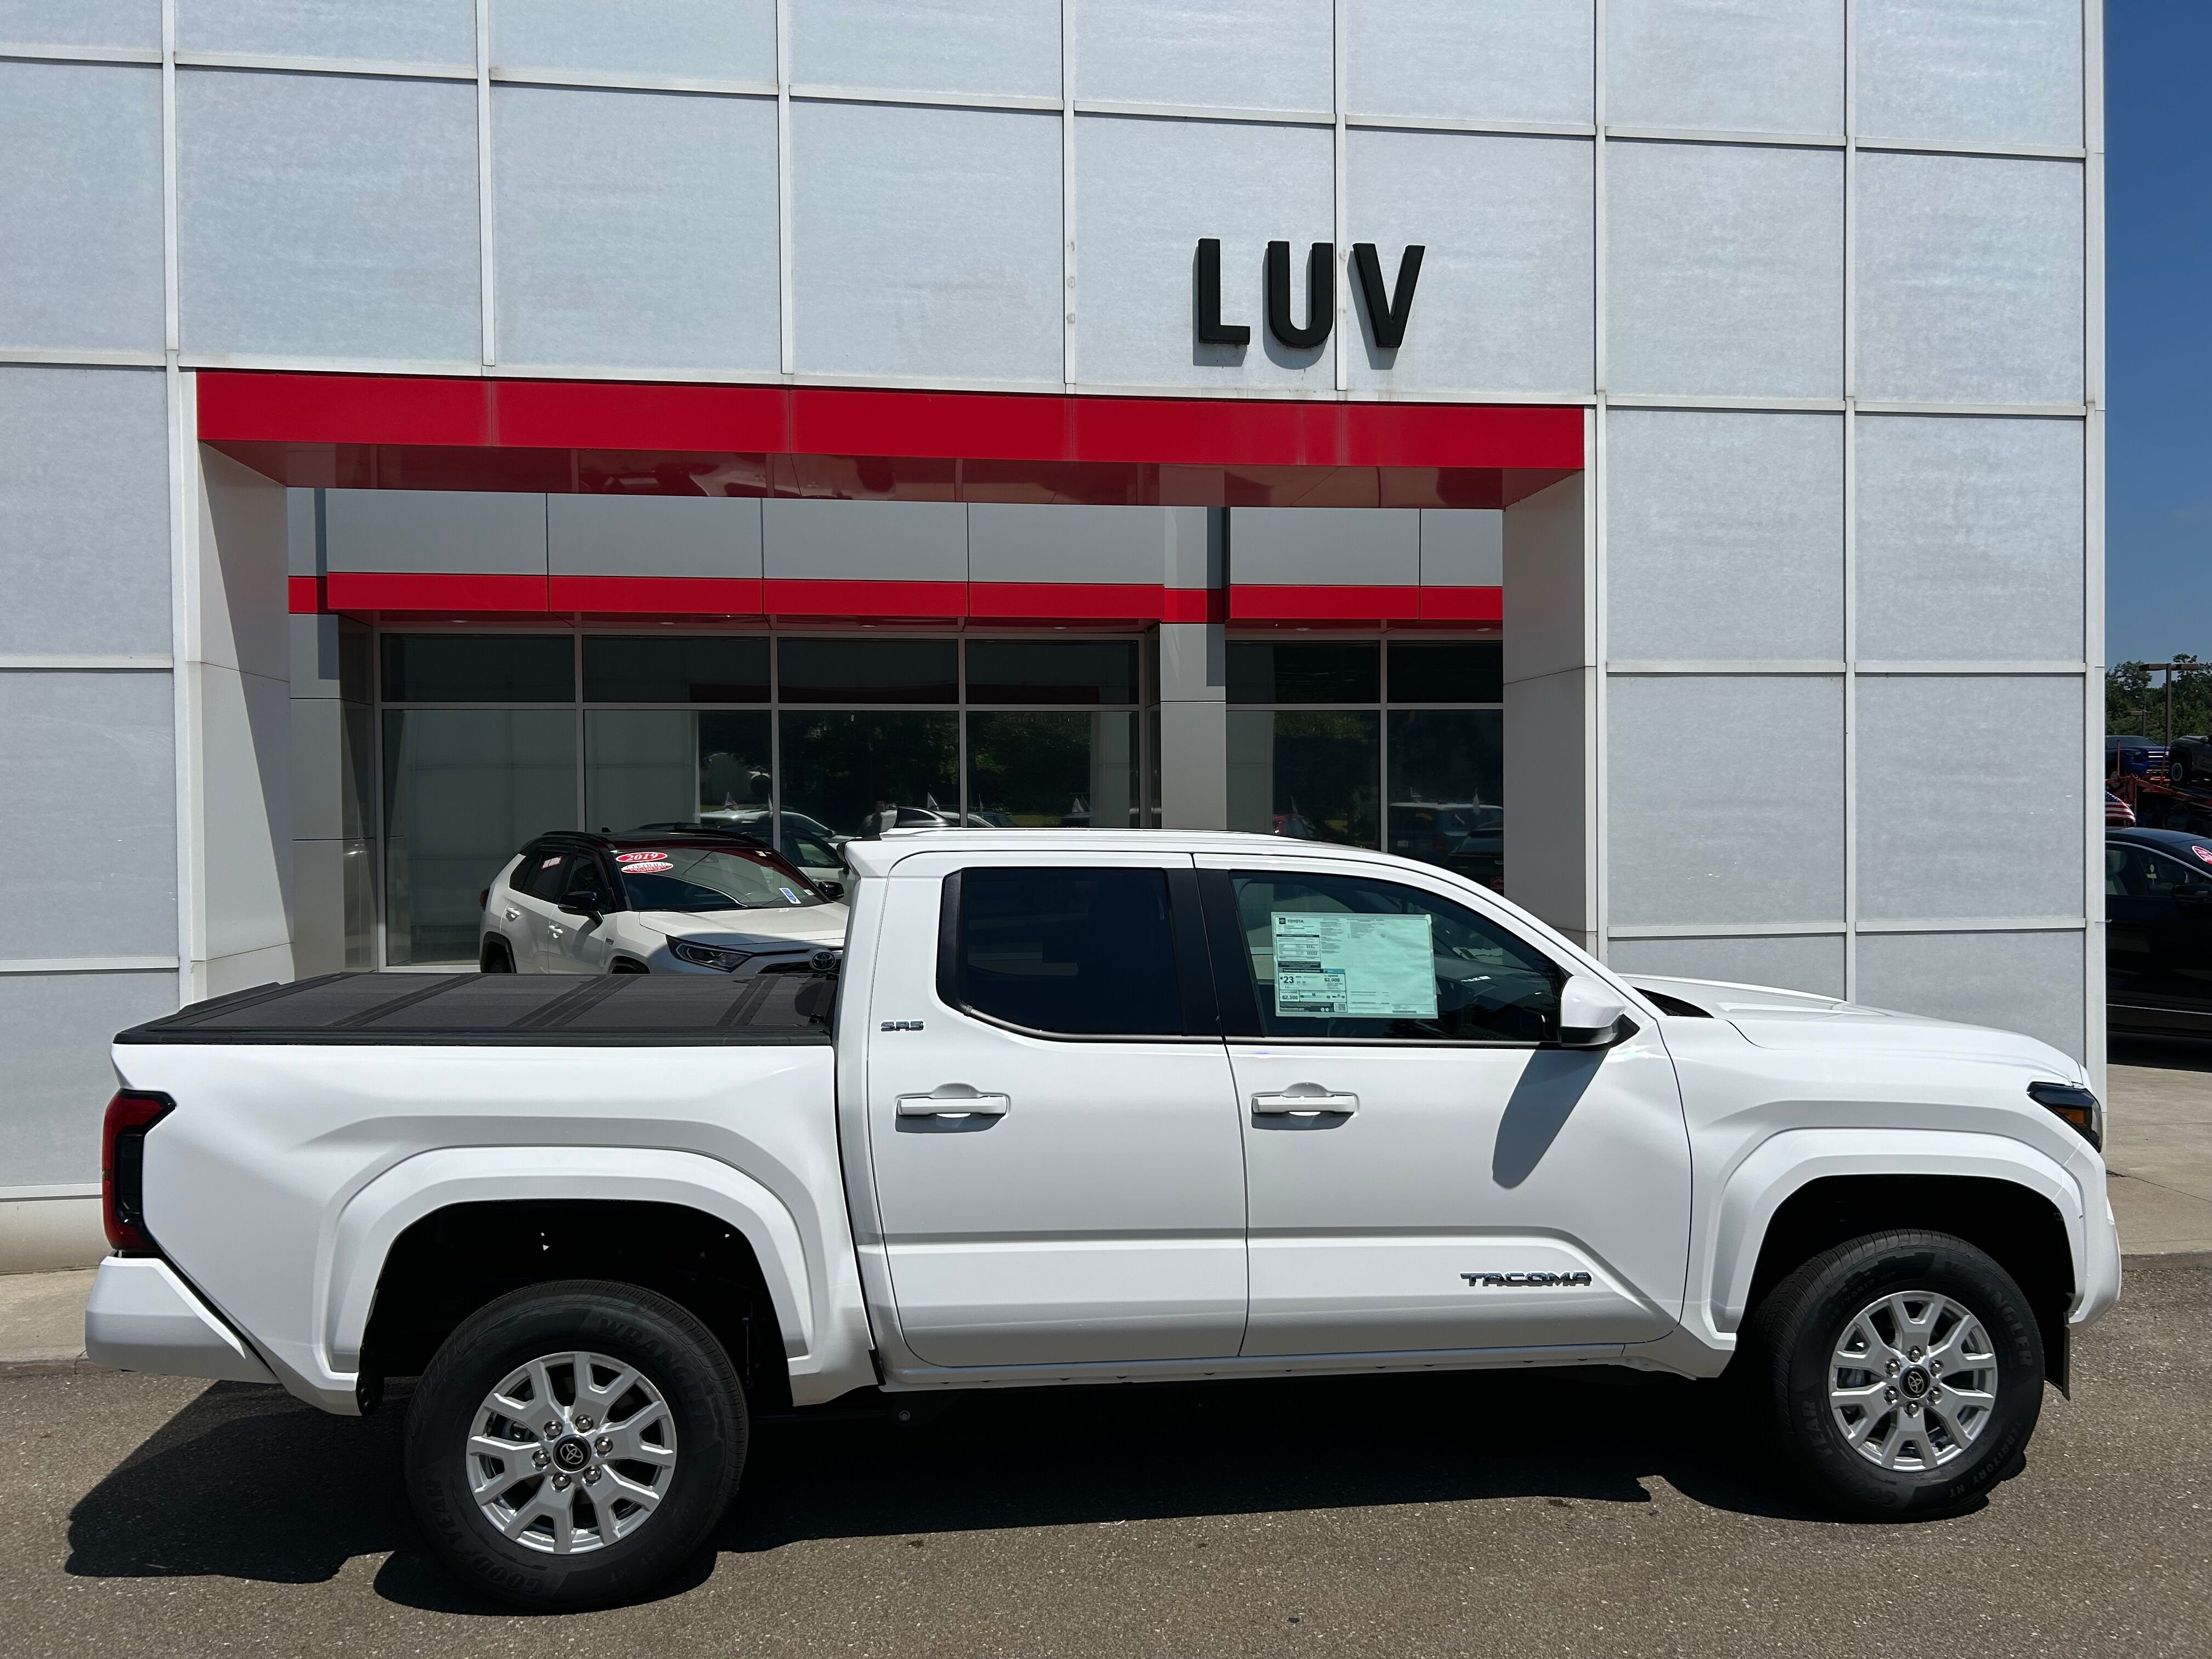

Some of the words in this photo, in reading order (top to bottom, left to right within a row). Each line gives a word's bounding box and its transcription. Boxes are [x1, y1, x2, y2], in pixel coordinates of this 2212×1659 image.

[1198, 238, 1425, 348] LUV
[625, 853, 659, 861] 2019
[1460, 1271, 1592, 1287] TACOMA
